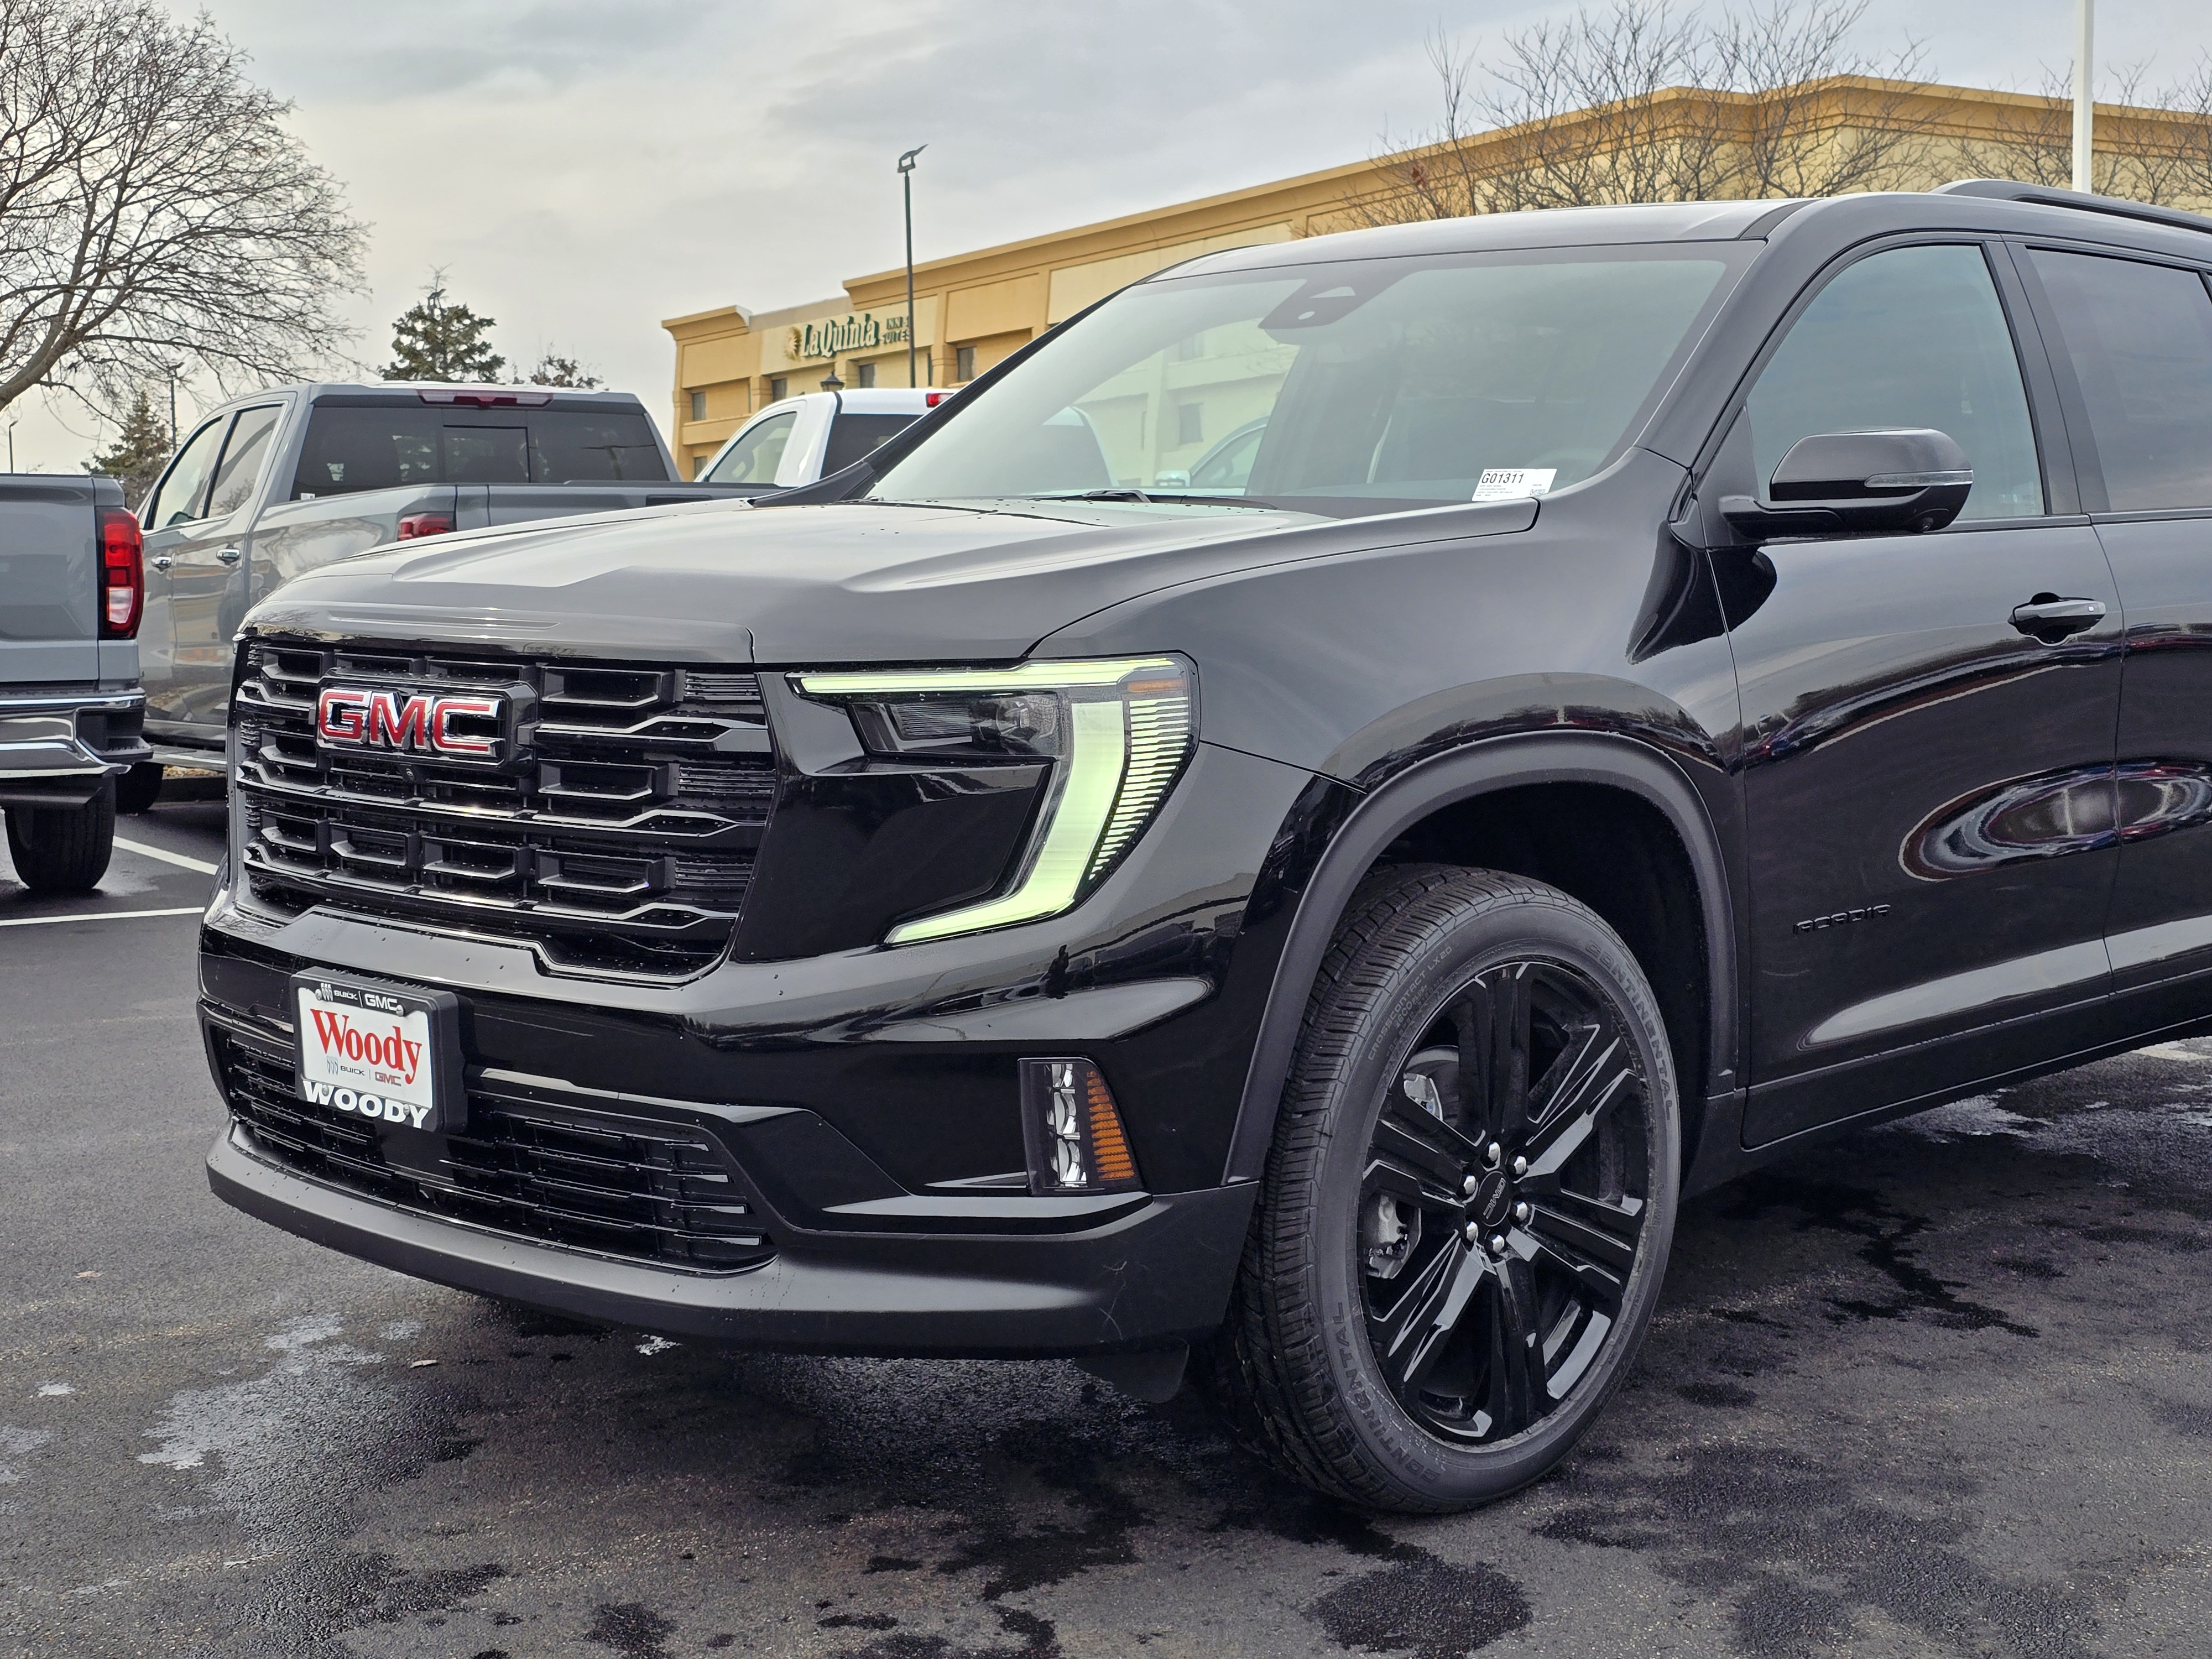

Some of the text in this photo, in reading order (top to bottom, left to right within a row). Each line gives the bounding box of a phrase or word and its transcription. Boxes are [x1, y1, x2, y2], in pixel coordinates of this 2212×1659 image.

[1481, 473, 1525, 484] G01311
[319, 688, 500, 757] GMC
[333, 990, 398, 1011] BUICK GMC
[310, 1008, 422, 1084] Woody
[340, 1065, 401, 1087] BUICK GMC
[302, 1080, 429, 1129] WOODY
[1483, 1177, 1506, 1219] GMC
